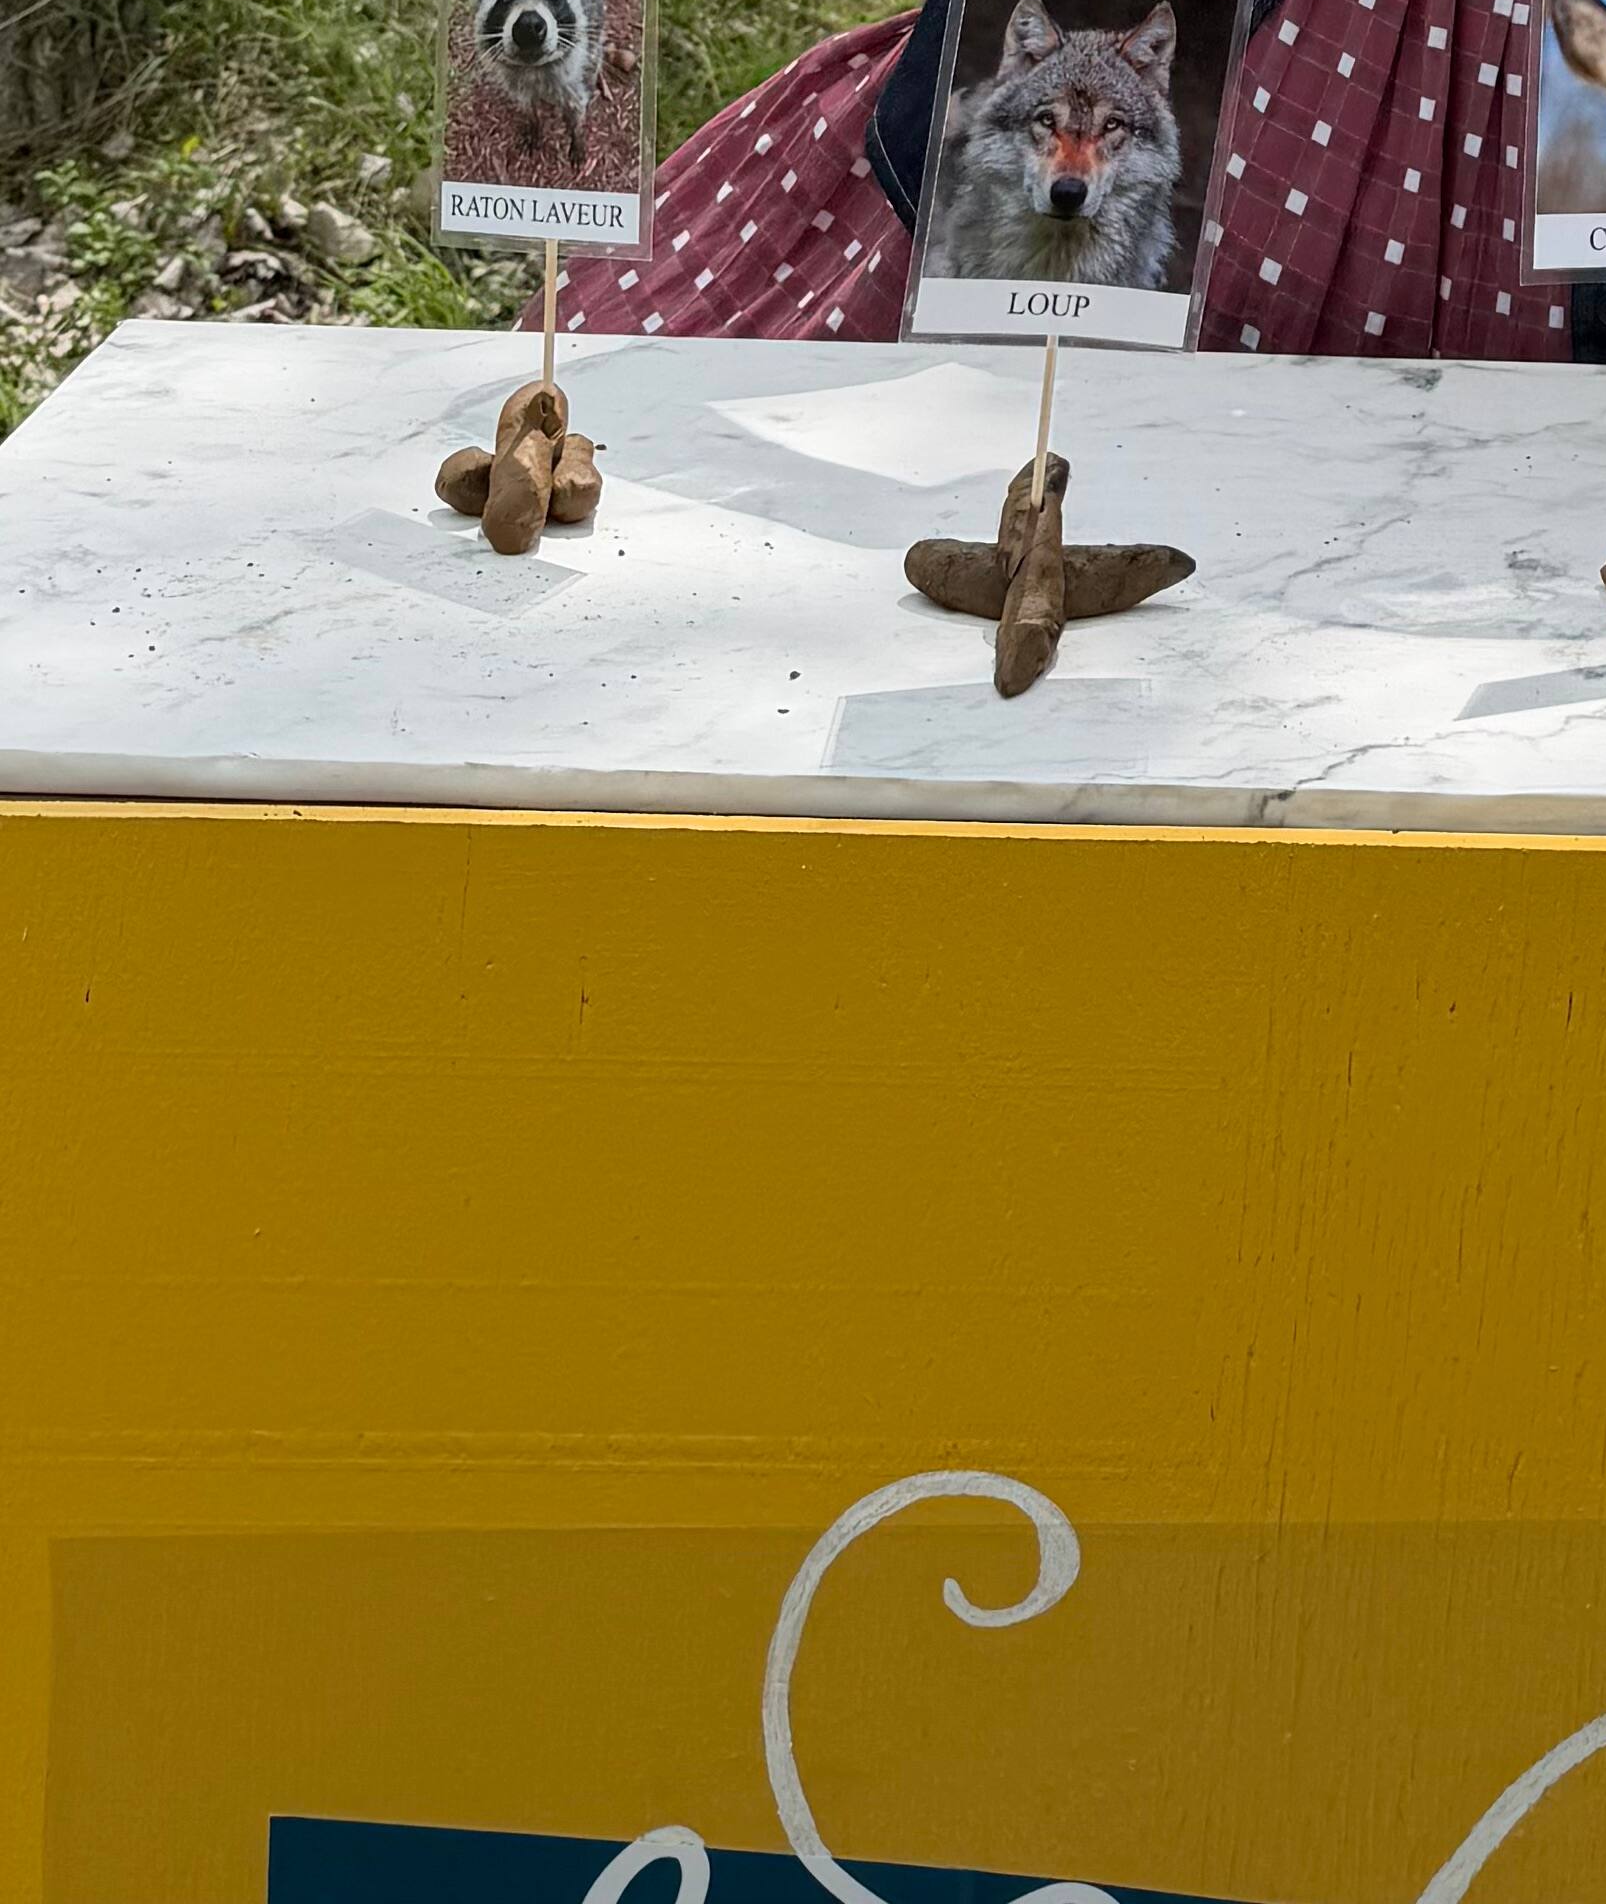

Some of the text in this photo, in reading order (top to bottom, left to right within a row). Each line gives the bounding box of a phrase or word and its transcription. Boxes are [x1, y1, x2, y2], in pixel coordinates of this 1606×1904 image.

[451, 194, 625, 228] RATON LAVEUR
[1007, 292, 1091, 318] LOUP
